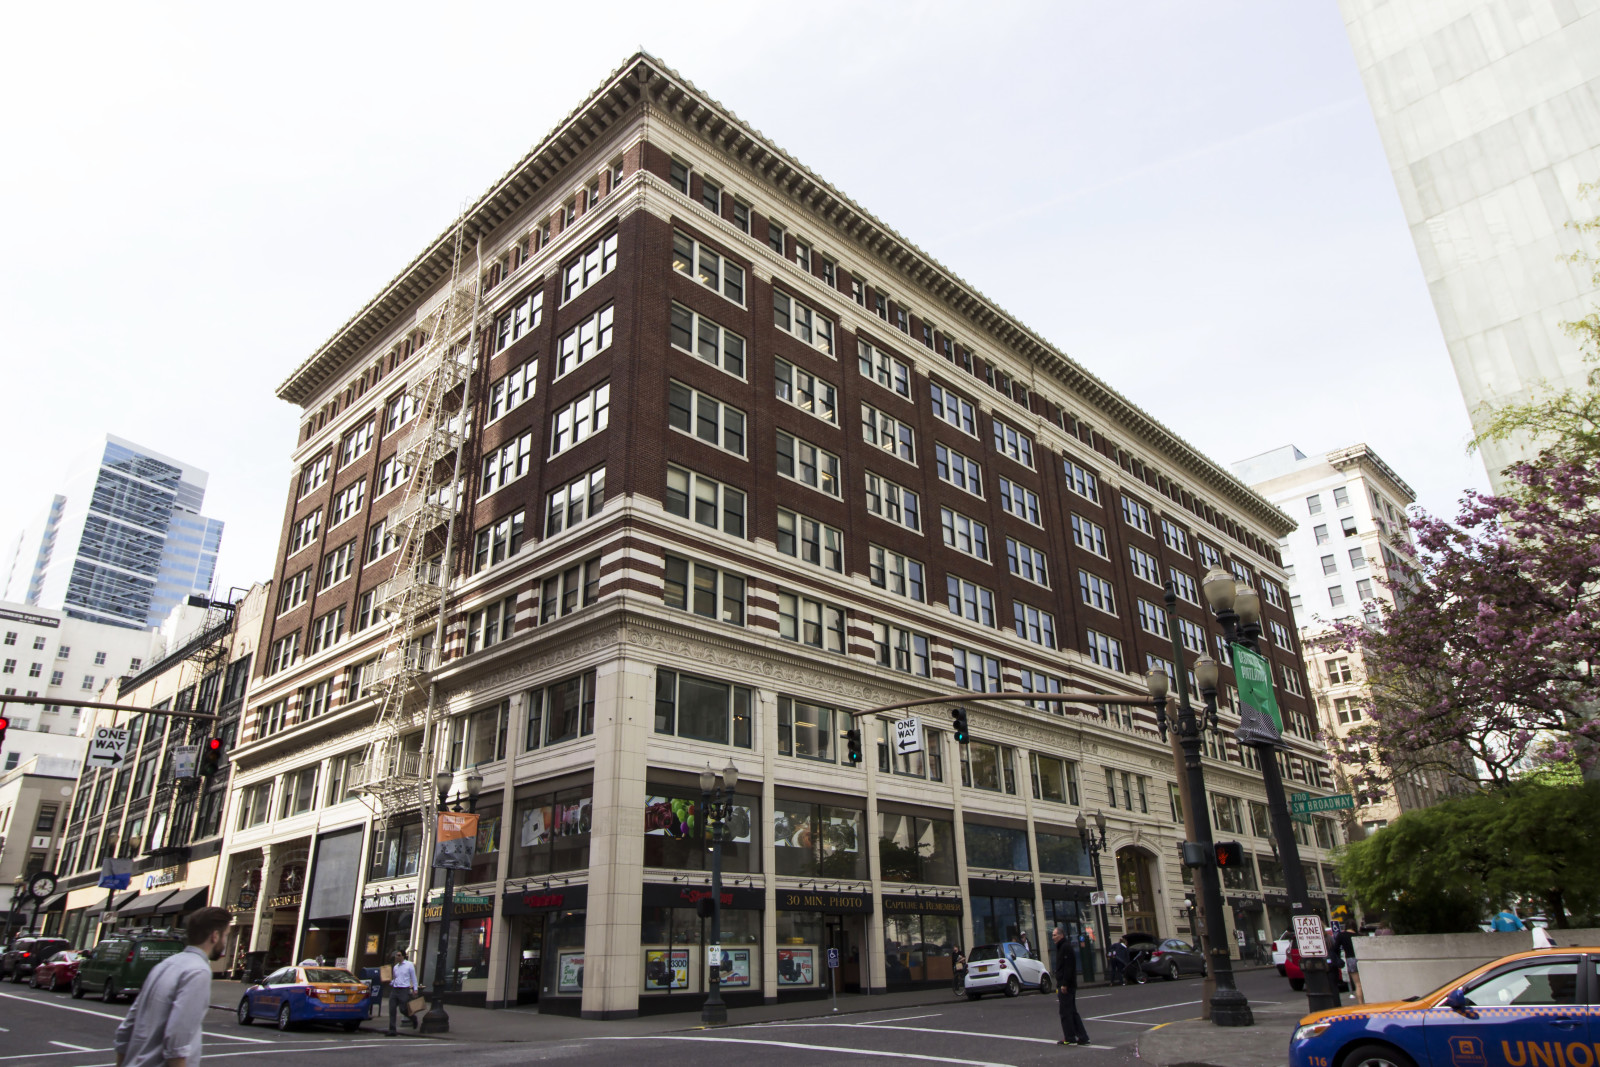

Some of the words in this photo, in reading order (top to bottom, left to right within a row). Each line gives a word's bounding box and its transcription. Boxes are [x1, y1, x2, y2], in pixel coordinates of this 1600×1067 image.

[898, 719, 915, 730] ONE
[98, 729, 127, 740] ONE
[898, 727, 916, 739] WAY
[95, 739, 125, 751] WAY
[1294, 793, 1307, 801] 700
[1293, 801, 1305, 813] SW
[1307, 796, 1351, 811] BROADWAY
[786, 894, 800, 906] 30
[804, 896, 826, 906] MIN.
[829, 896, 862, 908] PHOTO
[454, 903, 493, 915] CAMERAS
[1296, 918, 1317, 926] TAXI
[1297, 926, 1321, 936] ZONE
[564, 965, 575, 977] Buy
[561, 975, 577, 984] Local
[1501, 1040, 1600, 1067] UNIO
[1308, 1056, 1328, 1067] 116
